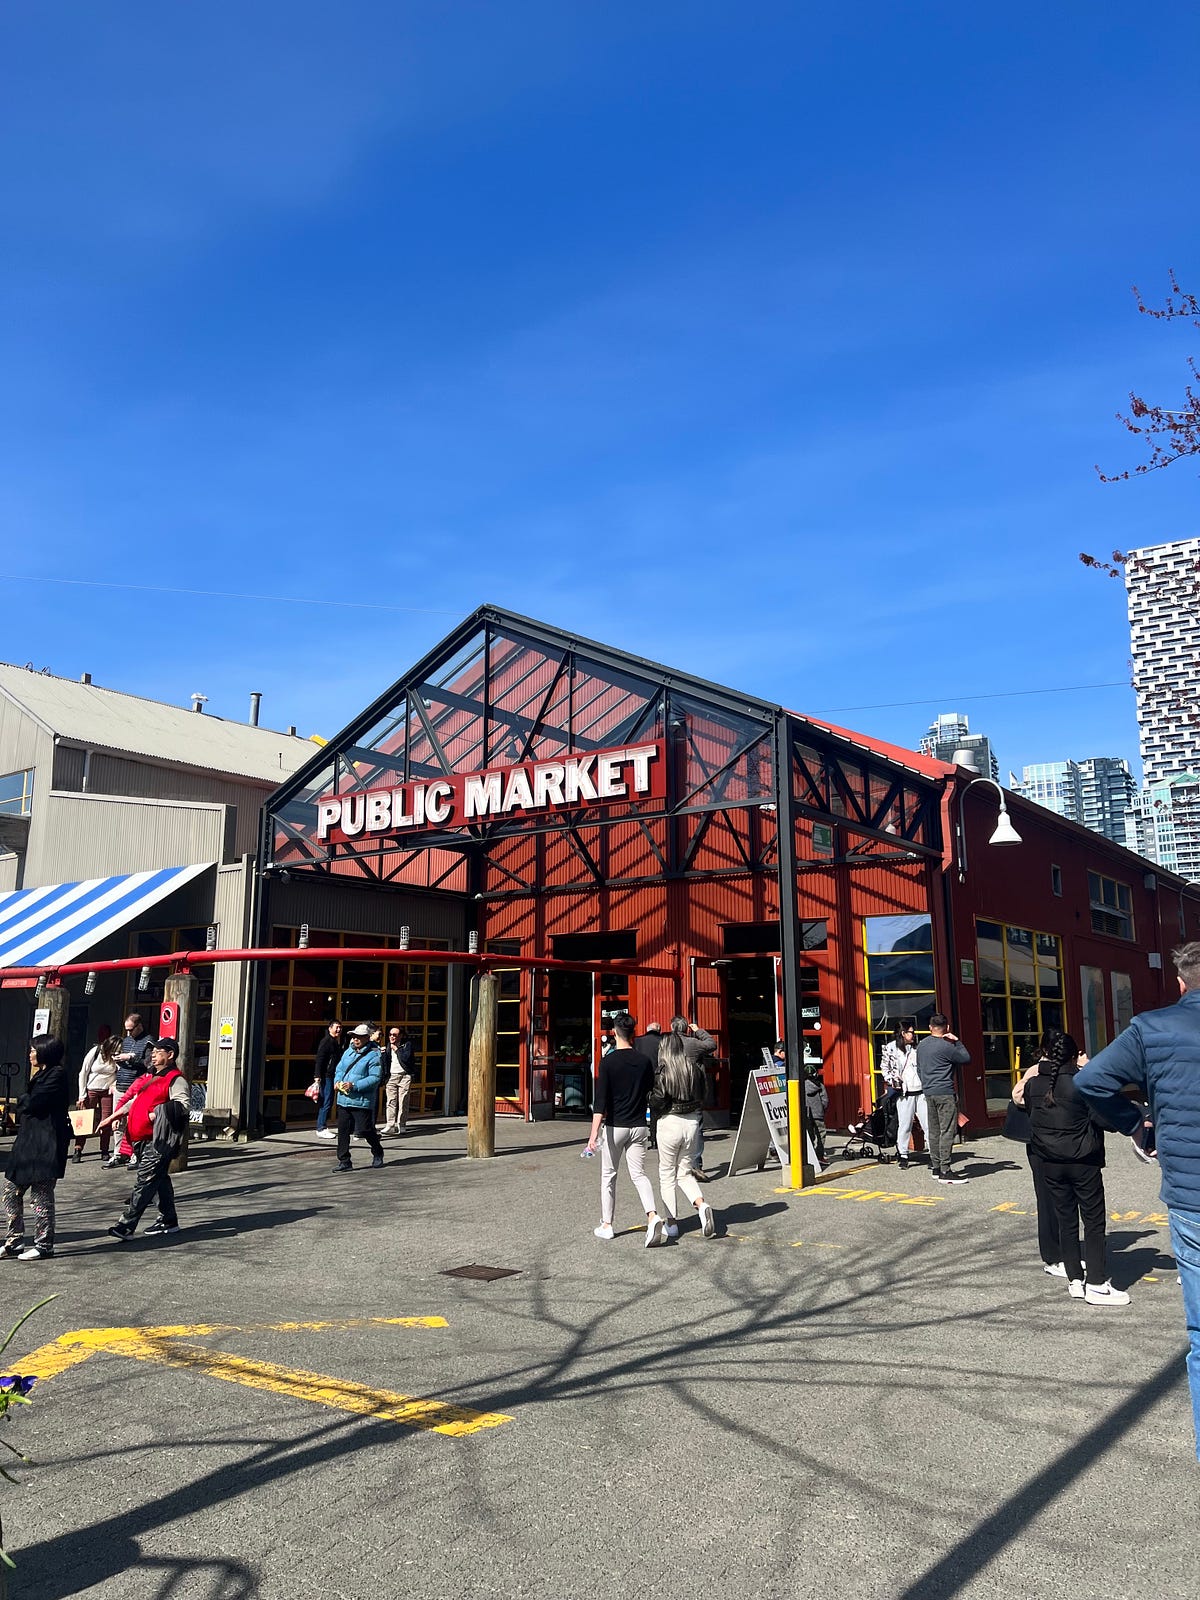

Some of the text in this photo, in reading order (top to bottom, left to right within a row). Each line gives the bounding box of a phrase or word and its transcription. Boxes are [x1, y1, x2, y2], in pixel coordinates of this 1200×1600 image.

[317, 744, 657, 839] PUBLIC MARKET
[794, 1187, 1168, 1226] FIRE LNE
